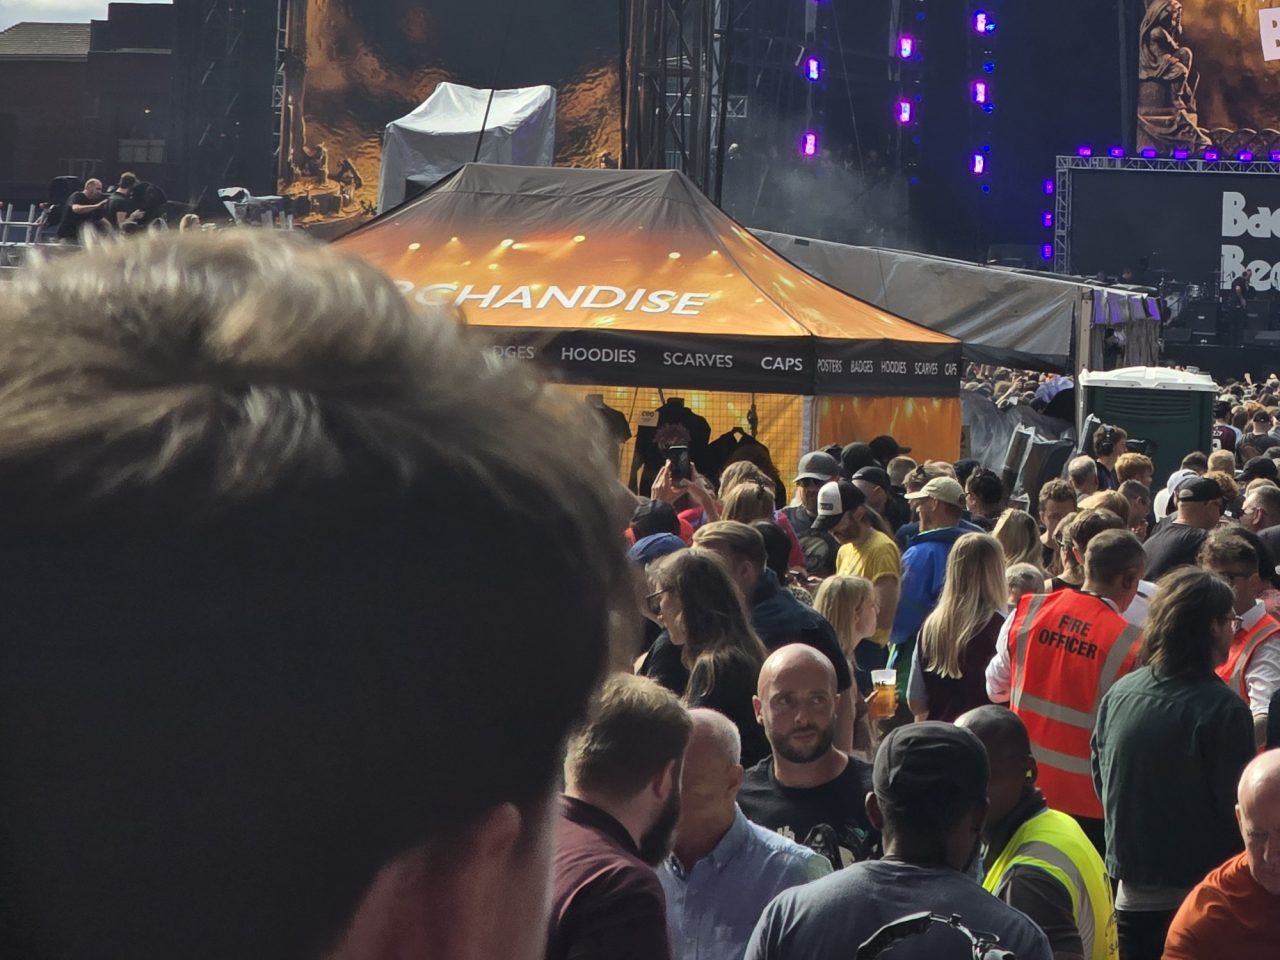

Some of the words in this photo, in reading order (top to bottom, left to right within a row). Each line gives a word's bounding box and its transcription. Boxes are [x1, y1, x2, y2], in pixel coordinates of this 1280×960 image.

[393, 280, 711, 315] CHANDISE
[561, 347, 637, 363] HOODIES
[663, 352, 734, 368] SCARVES
[760, 356, 803, 371] CAPS
[817, 359, 843, 373] POSTERS
[850, 360, 874, 373] BADGES
[881, 361, 907, 374] HOODIES
[914, 362, 938, 375] SCARVES
[944, 363, 957, 375] CAPS
[1058, 614, 1093, 637] FIRE
[1039, 628, 1098, 659] OFFICER
